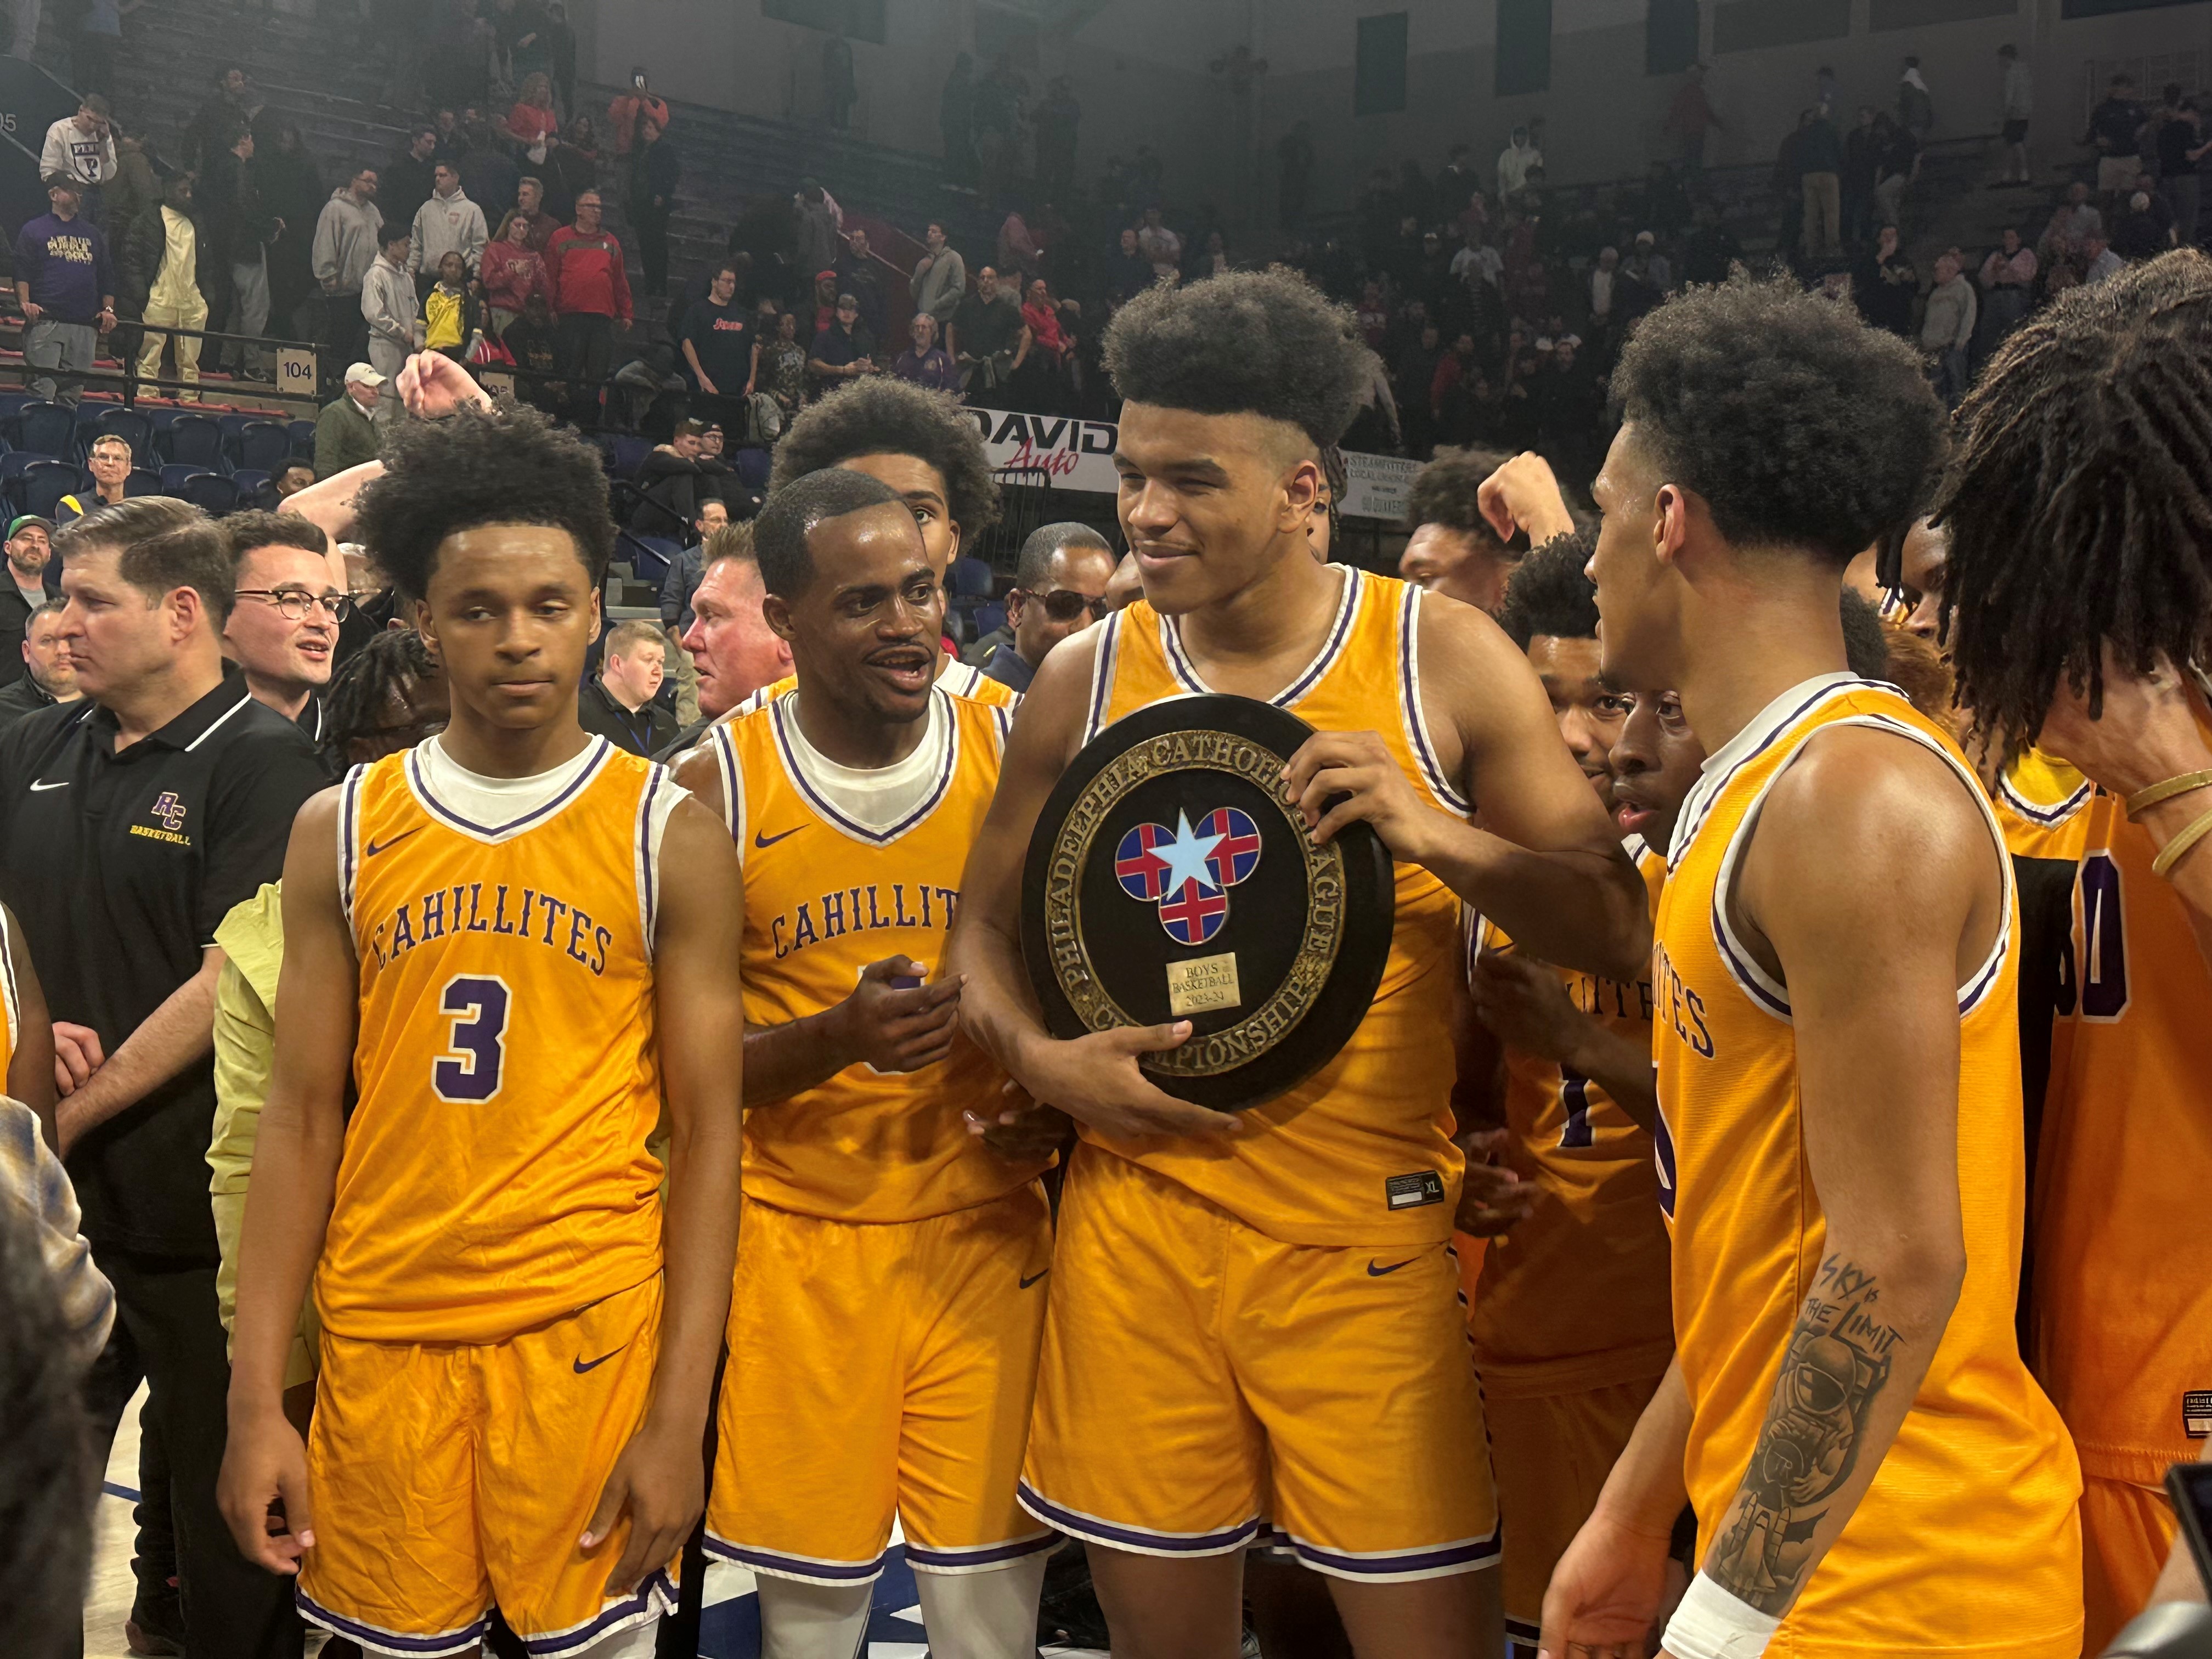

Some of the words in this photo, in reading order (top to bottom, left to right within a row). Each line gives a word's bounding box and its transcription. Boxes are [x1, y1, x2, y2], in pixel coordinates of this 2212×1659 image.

[283, 362, 312, 380] 104
[1003, 436, 1079, 477] Auto
[130, 825, 191, 845] BASKETBALL
[1051, 754, 1149, 991] PHILADELPHIA
[371, 882, 613, 977] CAHILLITES
[1172, 973, 1234, 994] BASKETBALL
[1186, 963, 1219, 978] BOYS
[431, 973, 512, 1104] 3
[1819, 1252, 1877, 1301] SKY
[1805, 1297, 1841, 1325] THE
[1829, 1301, 1907, 1355] LIMIT
